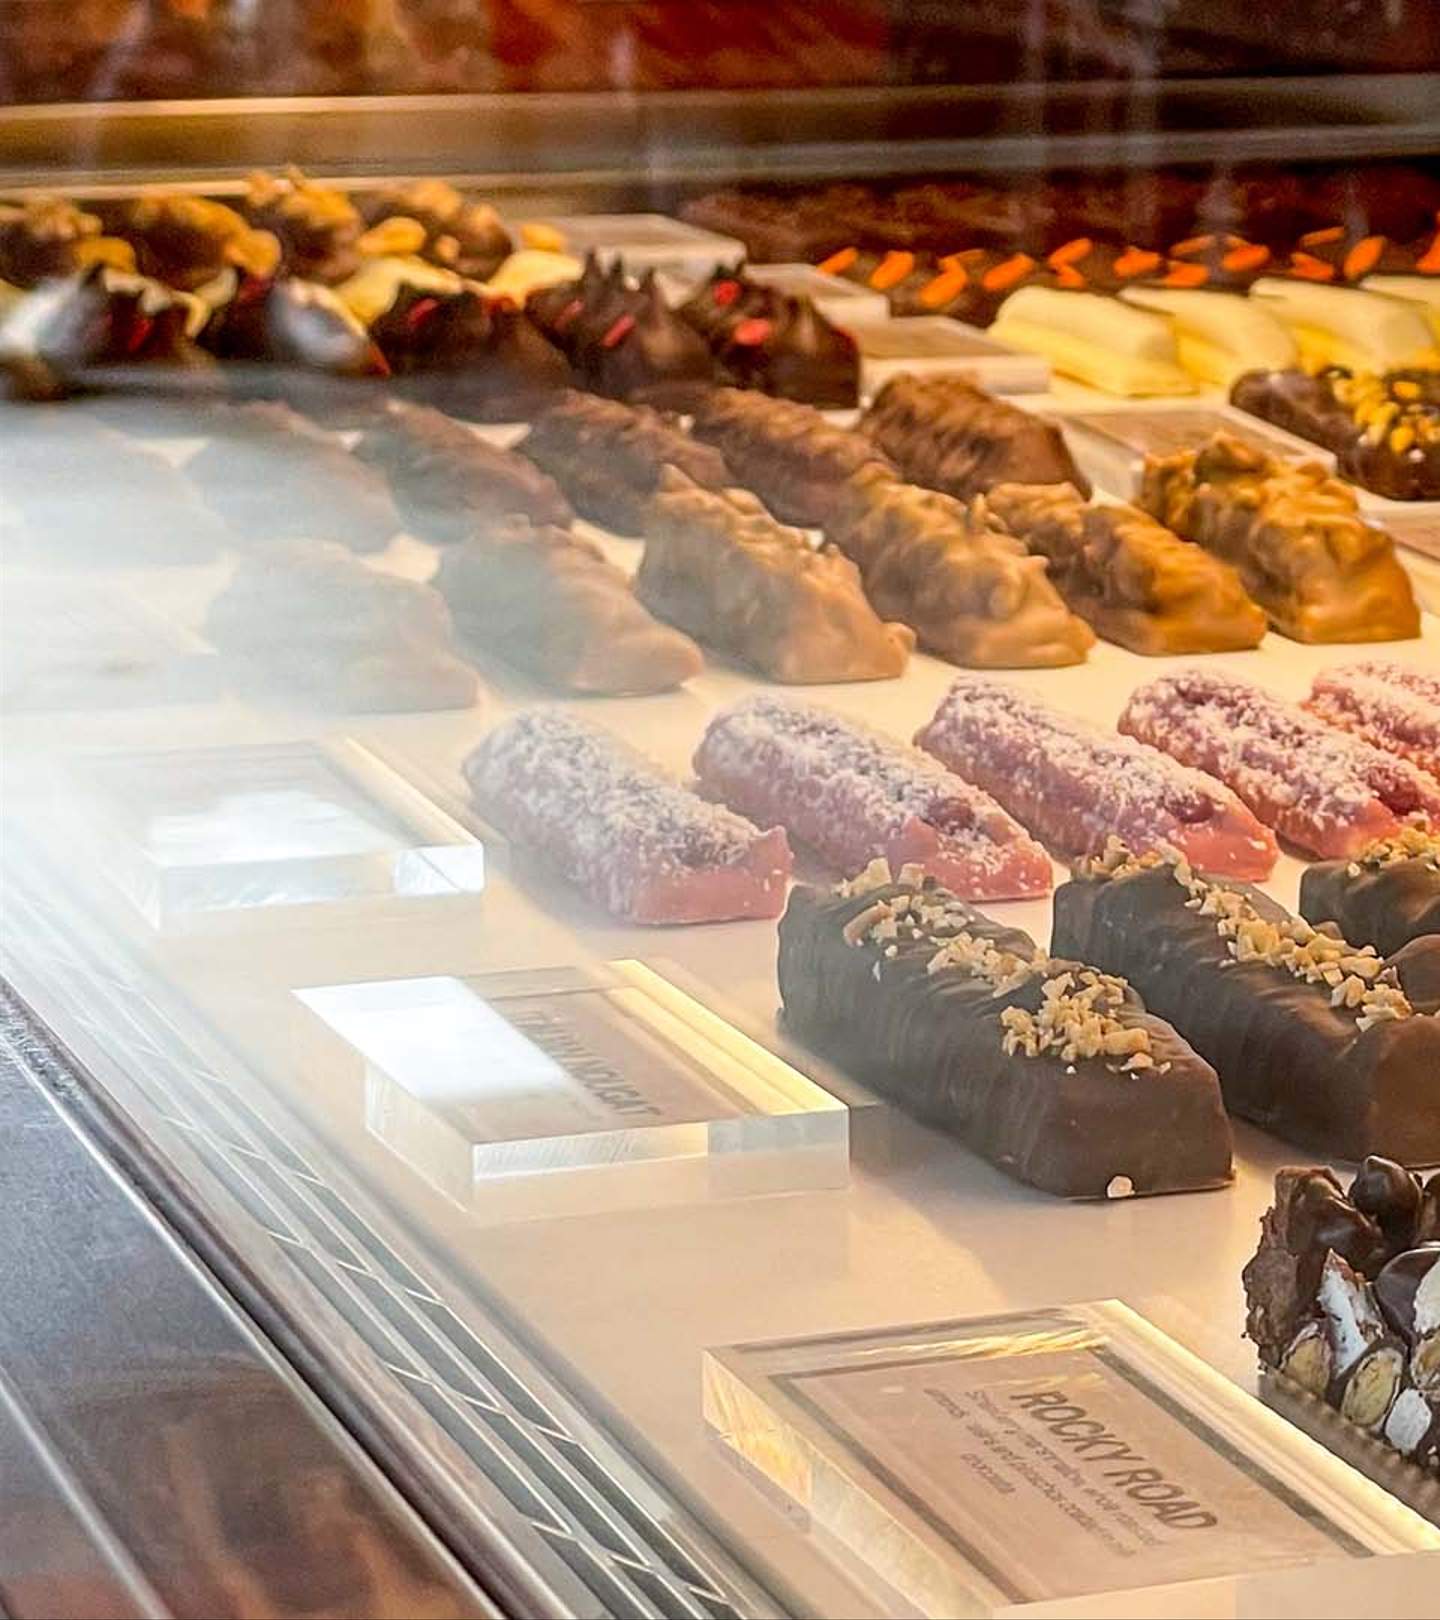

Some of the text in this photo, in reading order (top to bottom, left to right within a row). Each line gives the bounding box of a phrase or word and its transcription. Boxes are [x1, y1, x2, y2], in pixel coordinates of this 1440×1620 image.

[564, 1060, 662, 1116] NOUGAT
[1009, 1390, 1145, 1462] ROCKY
[1103, 1467, 1218, 1529] ROAD
